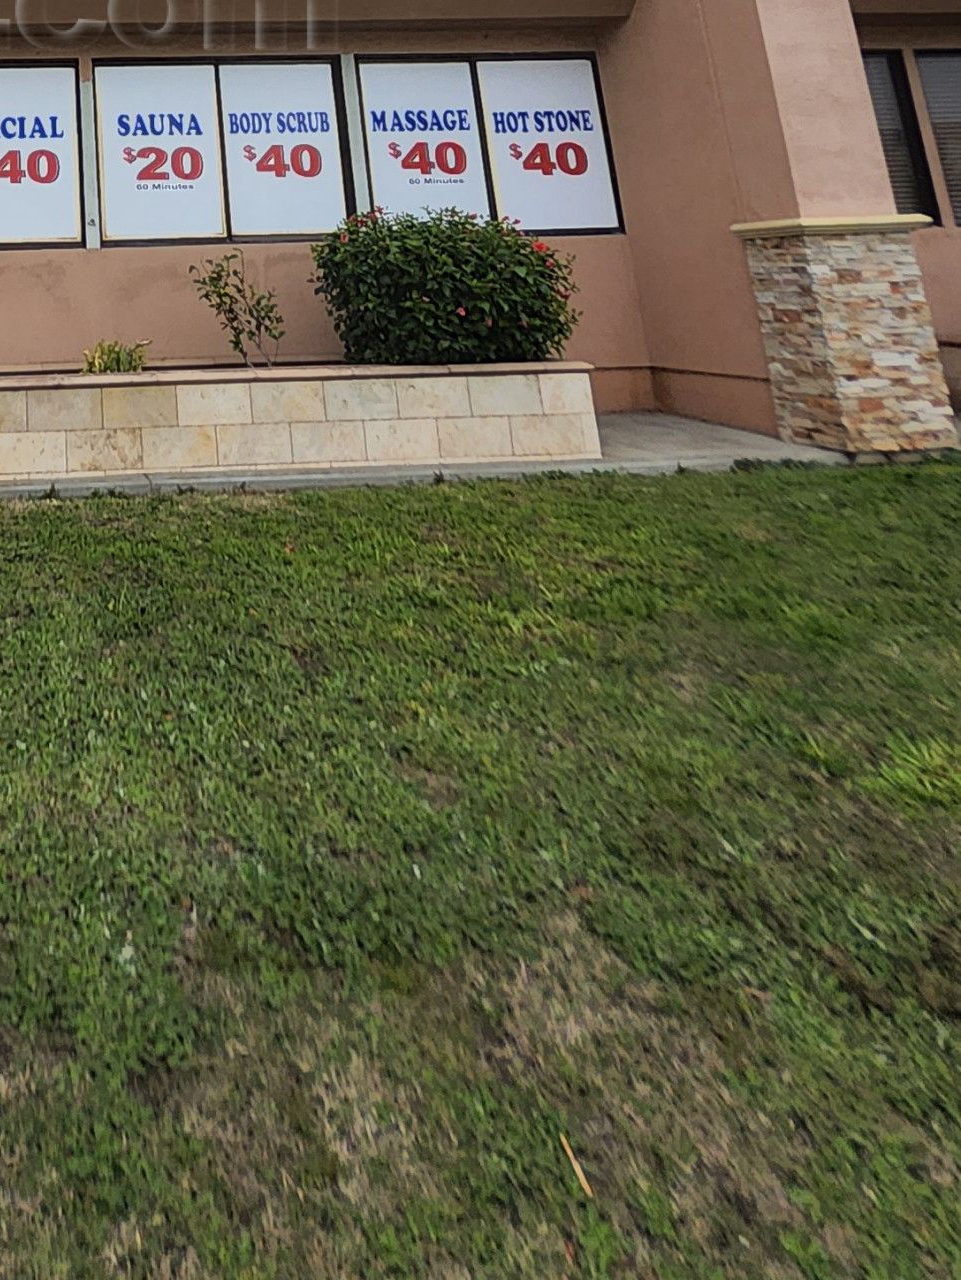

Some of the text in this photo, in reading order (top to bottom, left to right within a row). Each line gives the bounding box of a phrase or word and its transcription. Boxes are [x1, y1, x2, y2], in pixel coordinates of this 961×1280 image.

[117, 113, 203, 137] SAUNA
[228, 111, 330, 135] BODY SCRUB
[370, 109, 470, 133] MASSAGE
[492, 109, 594, 134] HOT STONE
[122, 146, 204, 181] $20
[243, 144, 323, 178] $40
[388, 141, 467, 175] $40
[509, 142, 588, 176] $40
[152, 183, 194, 191] Minutes
